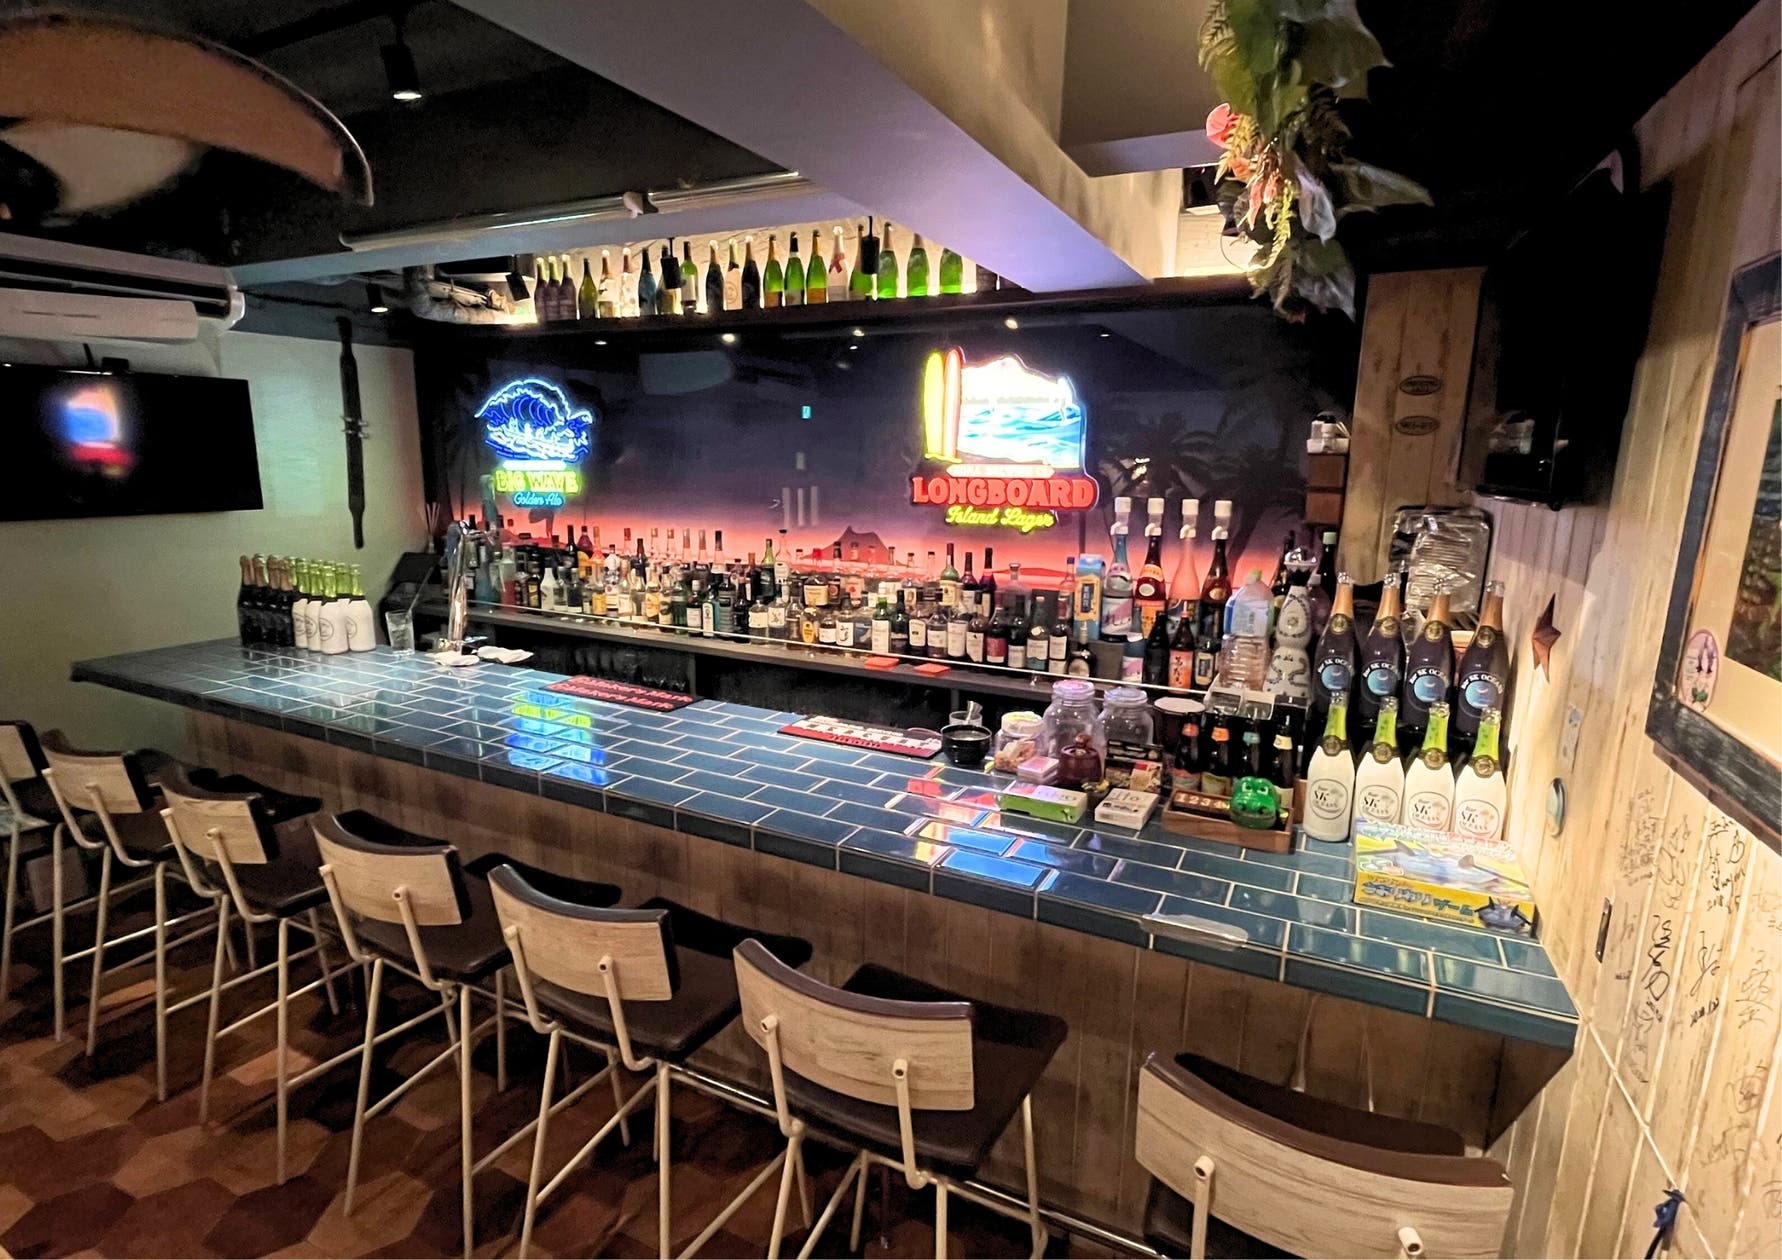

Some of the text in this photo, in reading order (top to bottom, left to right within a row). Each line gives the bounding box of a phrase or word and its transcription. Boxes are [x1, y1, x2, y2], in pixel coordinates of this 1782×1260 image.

[495, 470, 579, 494] BIG WAVE
[912, 477, 1095, 509] LONGBOARD
[513, 491, 545, 506] Golden
[945, 505, 1055, 533] Island Lager
